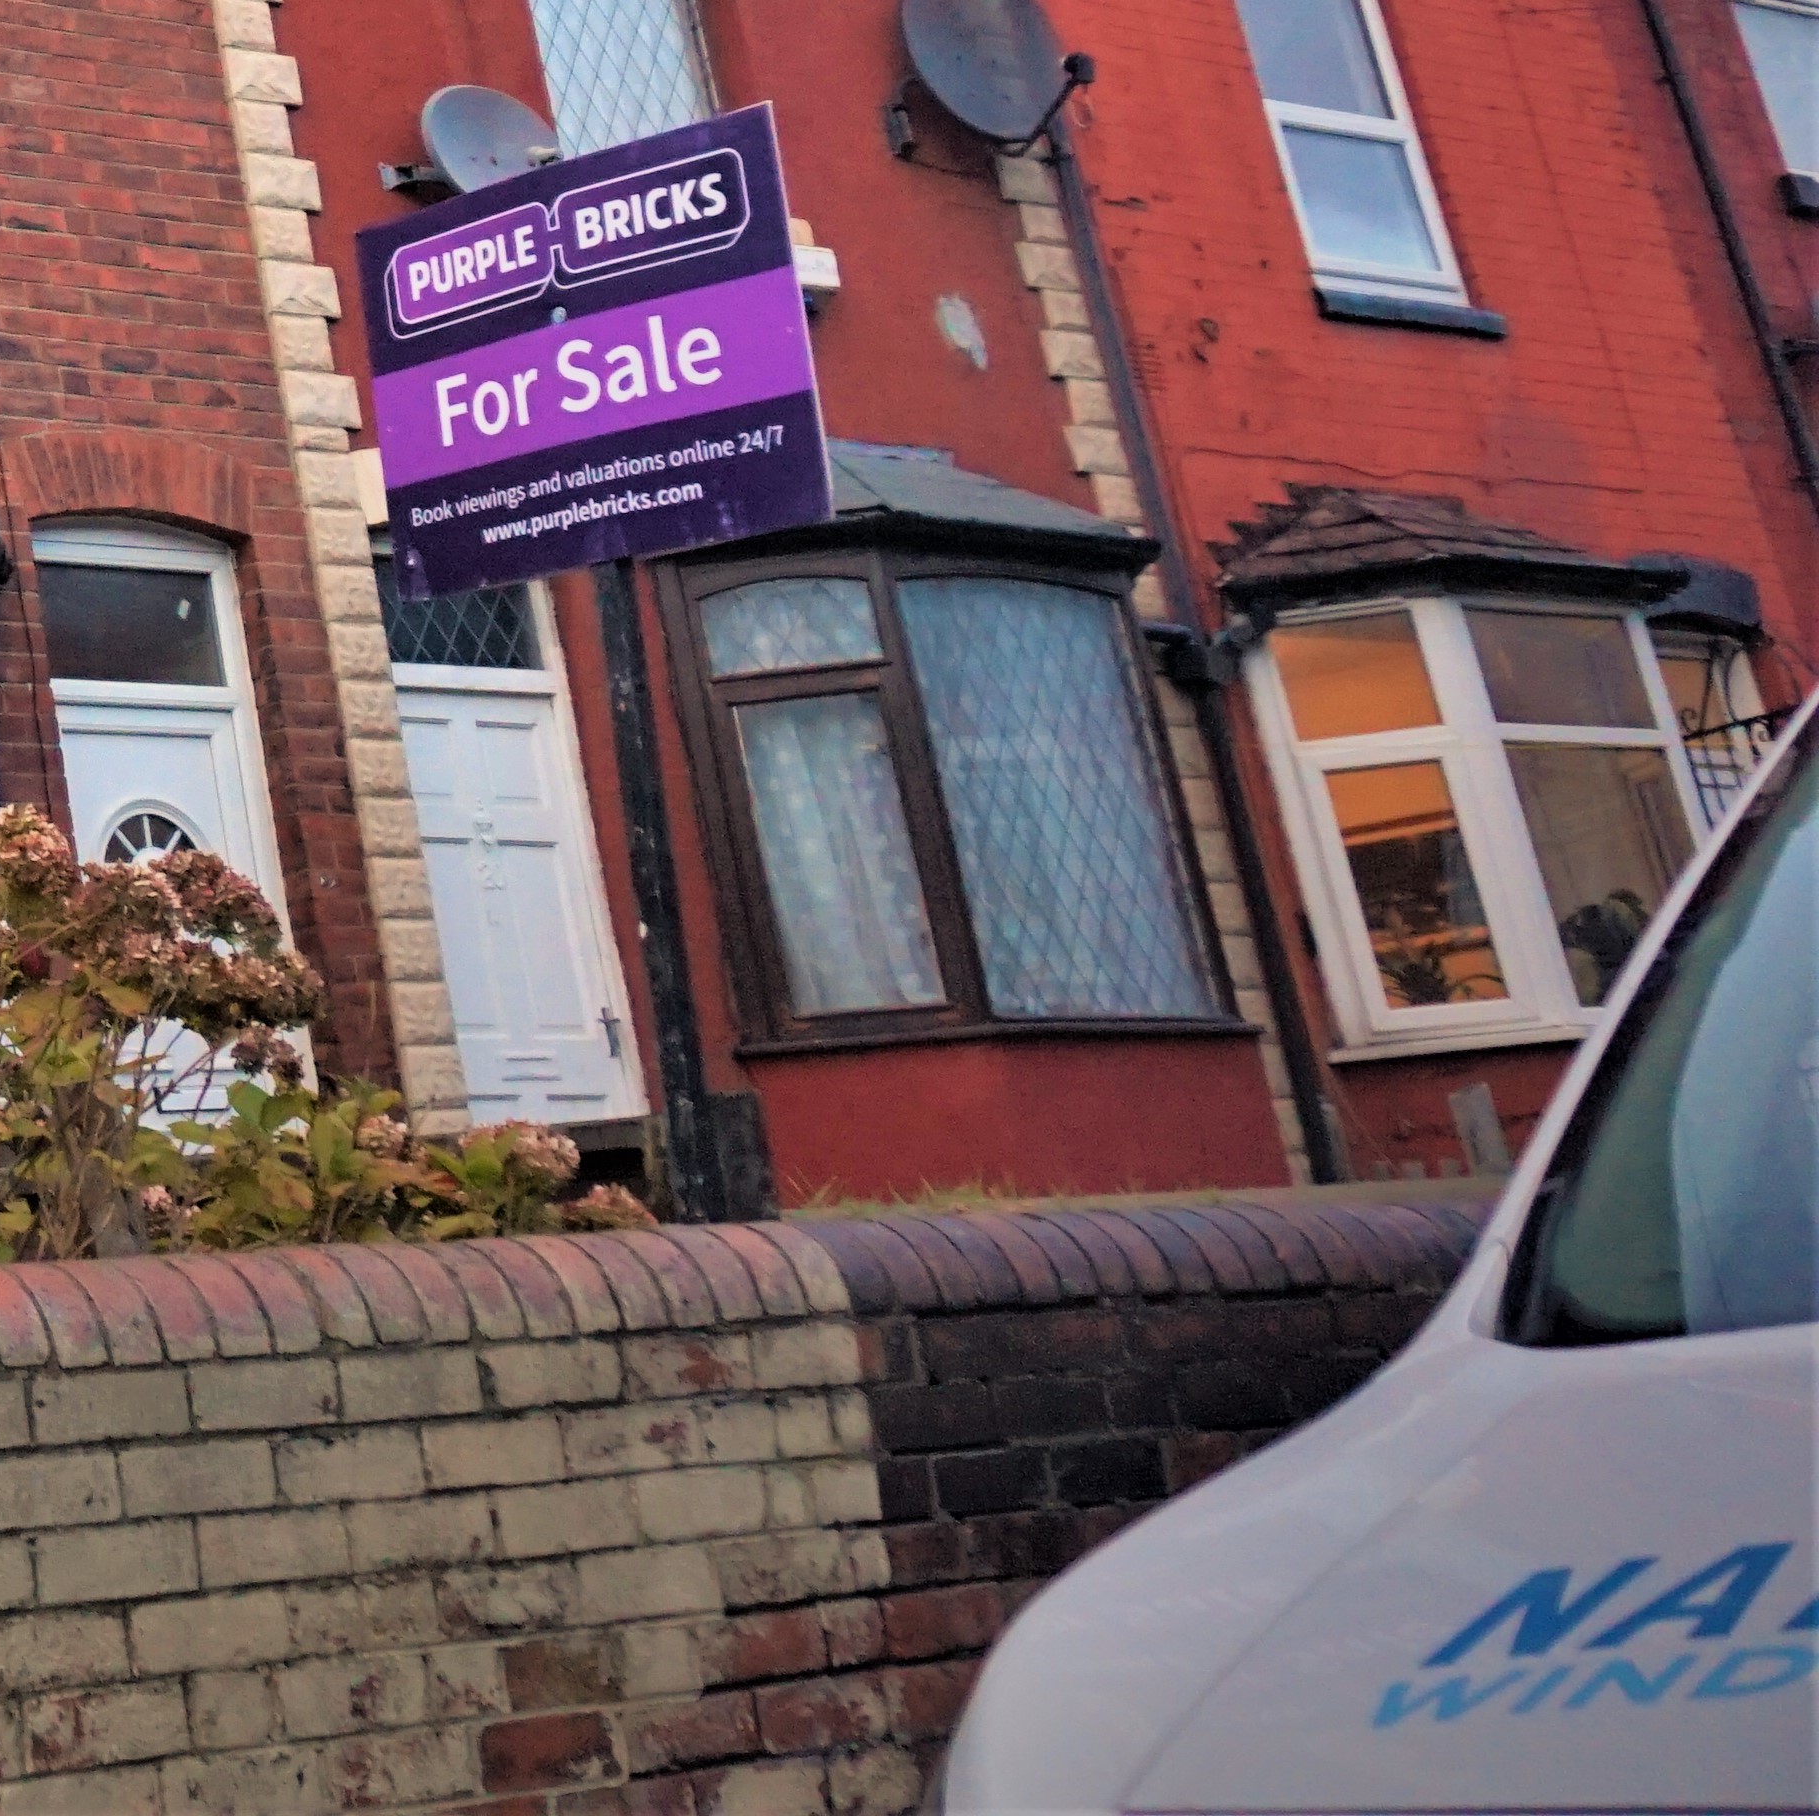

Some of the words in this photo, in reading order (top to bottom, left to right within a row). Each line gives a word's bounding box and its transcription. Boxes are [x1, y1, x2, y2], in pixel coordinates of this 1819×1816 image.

[408, 224, 537, 302] PURPLE
[574, 172, 727, 250] BRICKS
[435, 366, 538, 447] For
[556, 315, 723, 413] Sale
[411, 498, 455, 527] Book
[454, 487, 526, 517] viewings
[528, 470, 561, 498] and
[564, 456, 666, 489] valuations
[669, 439, 735, 467] online
[738, 424, 784, 453] 24/7
[482, 482, 704, 544] www.purplebricks.com
[1418, 1540, 1819, 1670] NA
